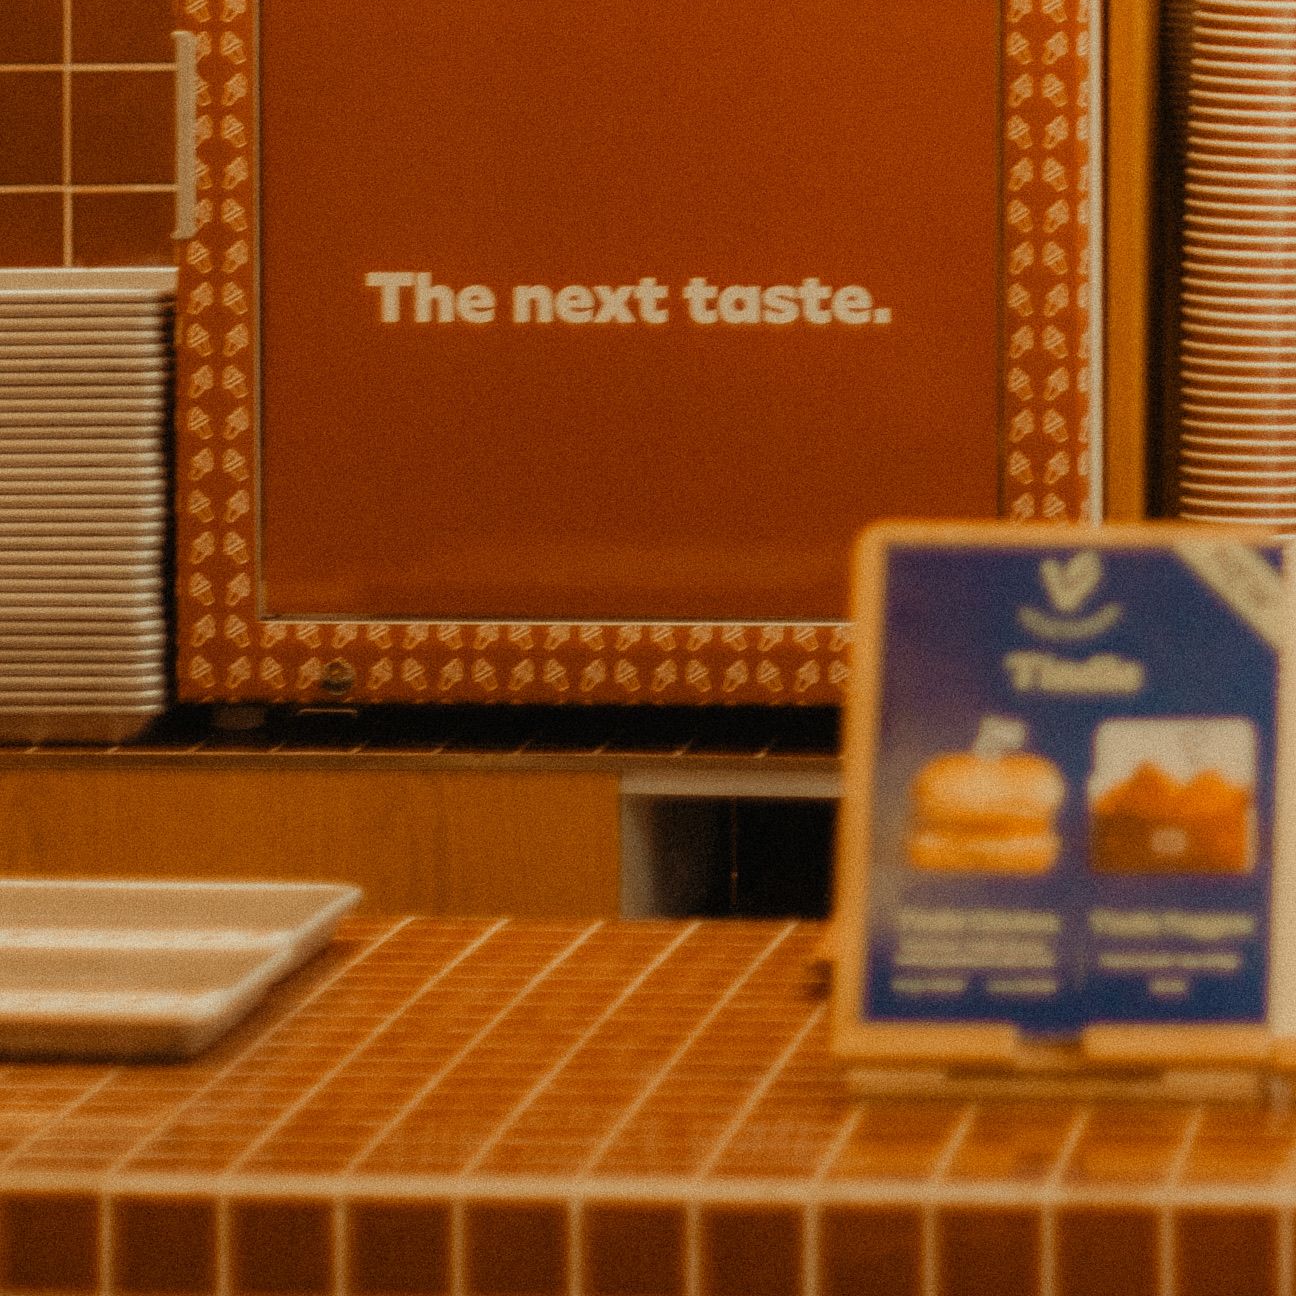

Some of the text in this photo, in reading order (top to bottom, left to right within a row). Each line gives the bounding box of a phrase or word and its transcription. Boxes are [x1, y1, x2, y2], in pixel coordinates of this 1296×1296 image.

[364, 271, 893, 324] The next taste.
